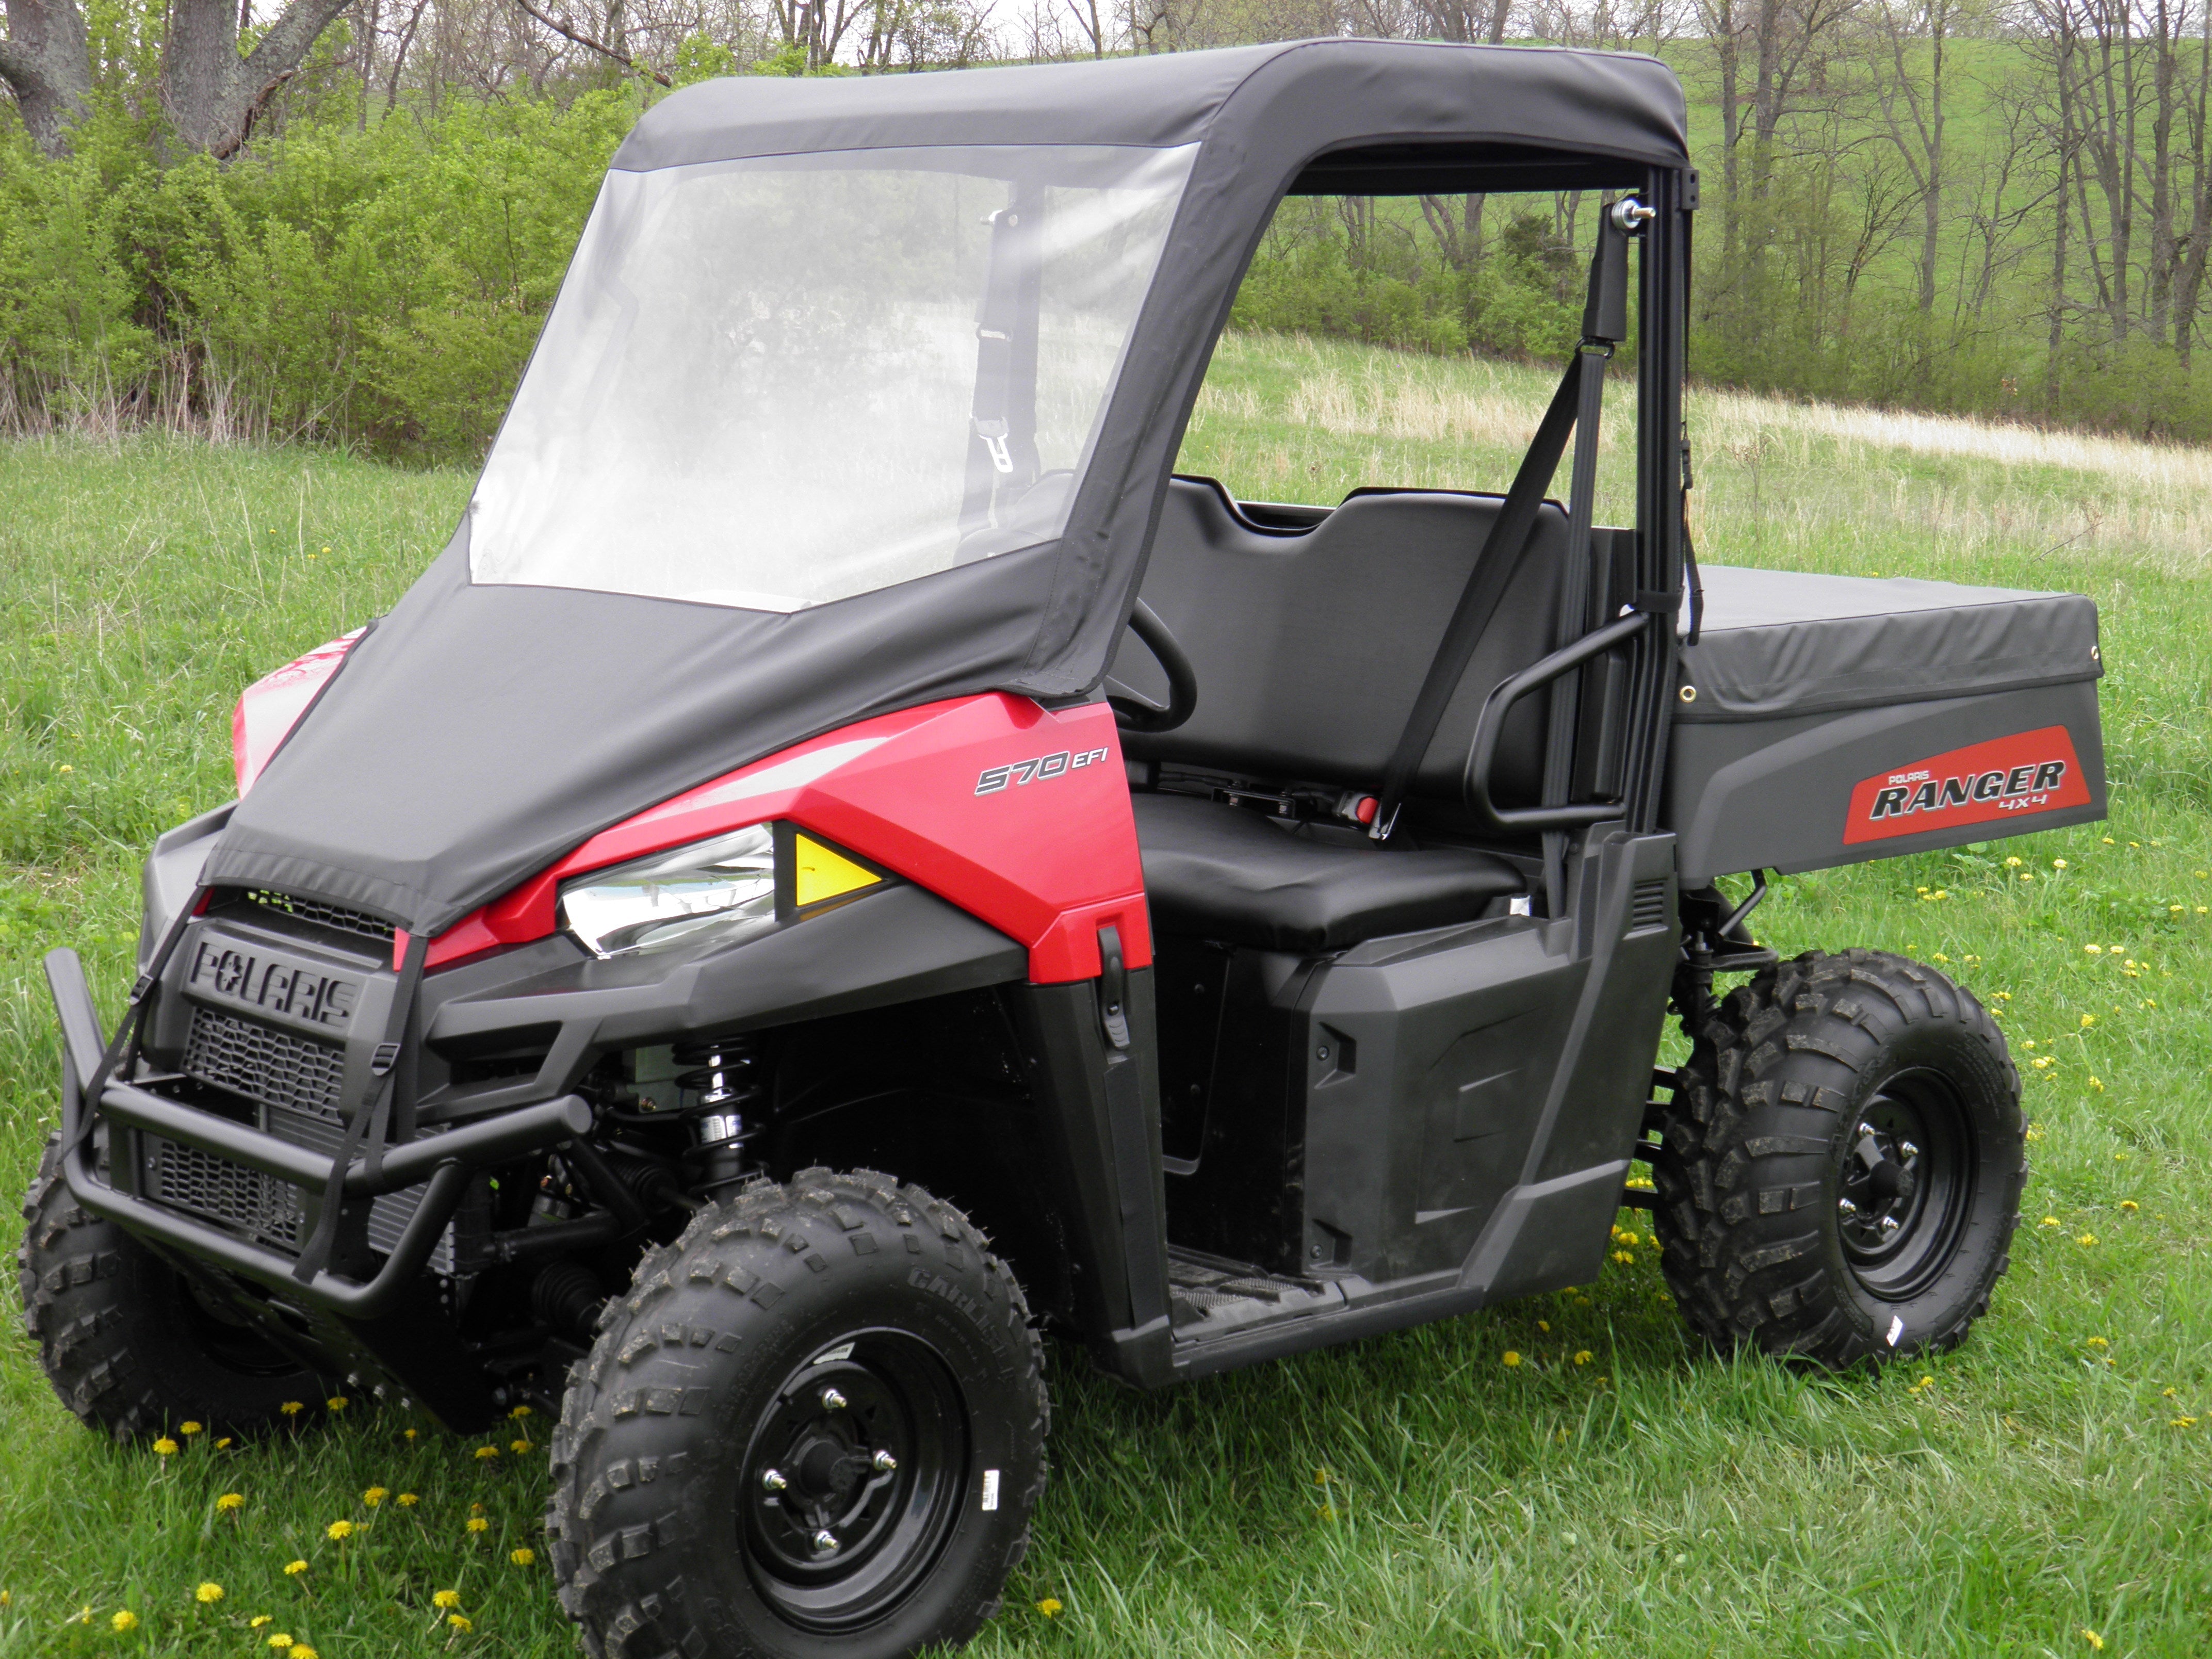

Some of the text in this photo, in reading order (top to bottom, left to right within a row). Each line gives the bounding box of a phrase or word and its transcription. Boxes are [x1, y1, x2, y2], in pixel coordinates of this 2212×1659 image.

[974, 747, 1109, 796] 570 EFI
[1869, 760, 2067, 821] RANGER
[1889, 771, 1929, 785] POLARIS
[190, 941, 357, 1028] POLARIS
